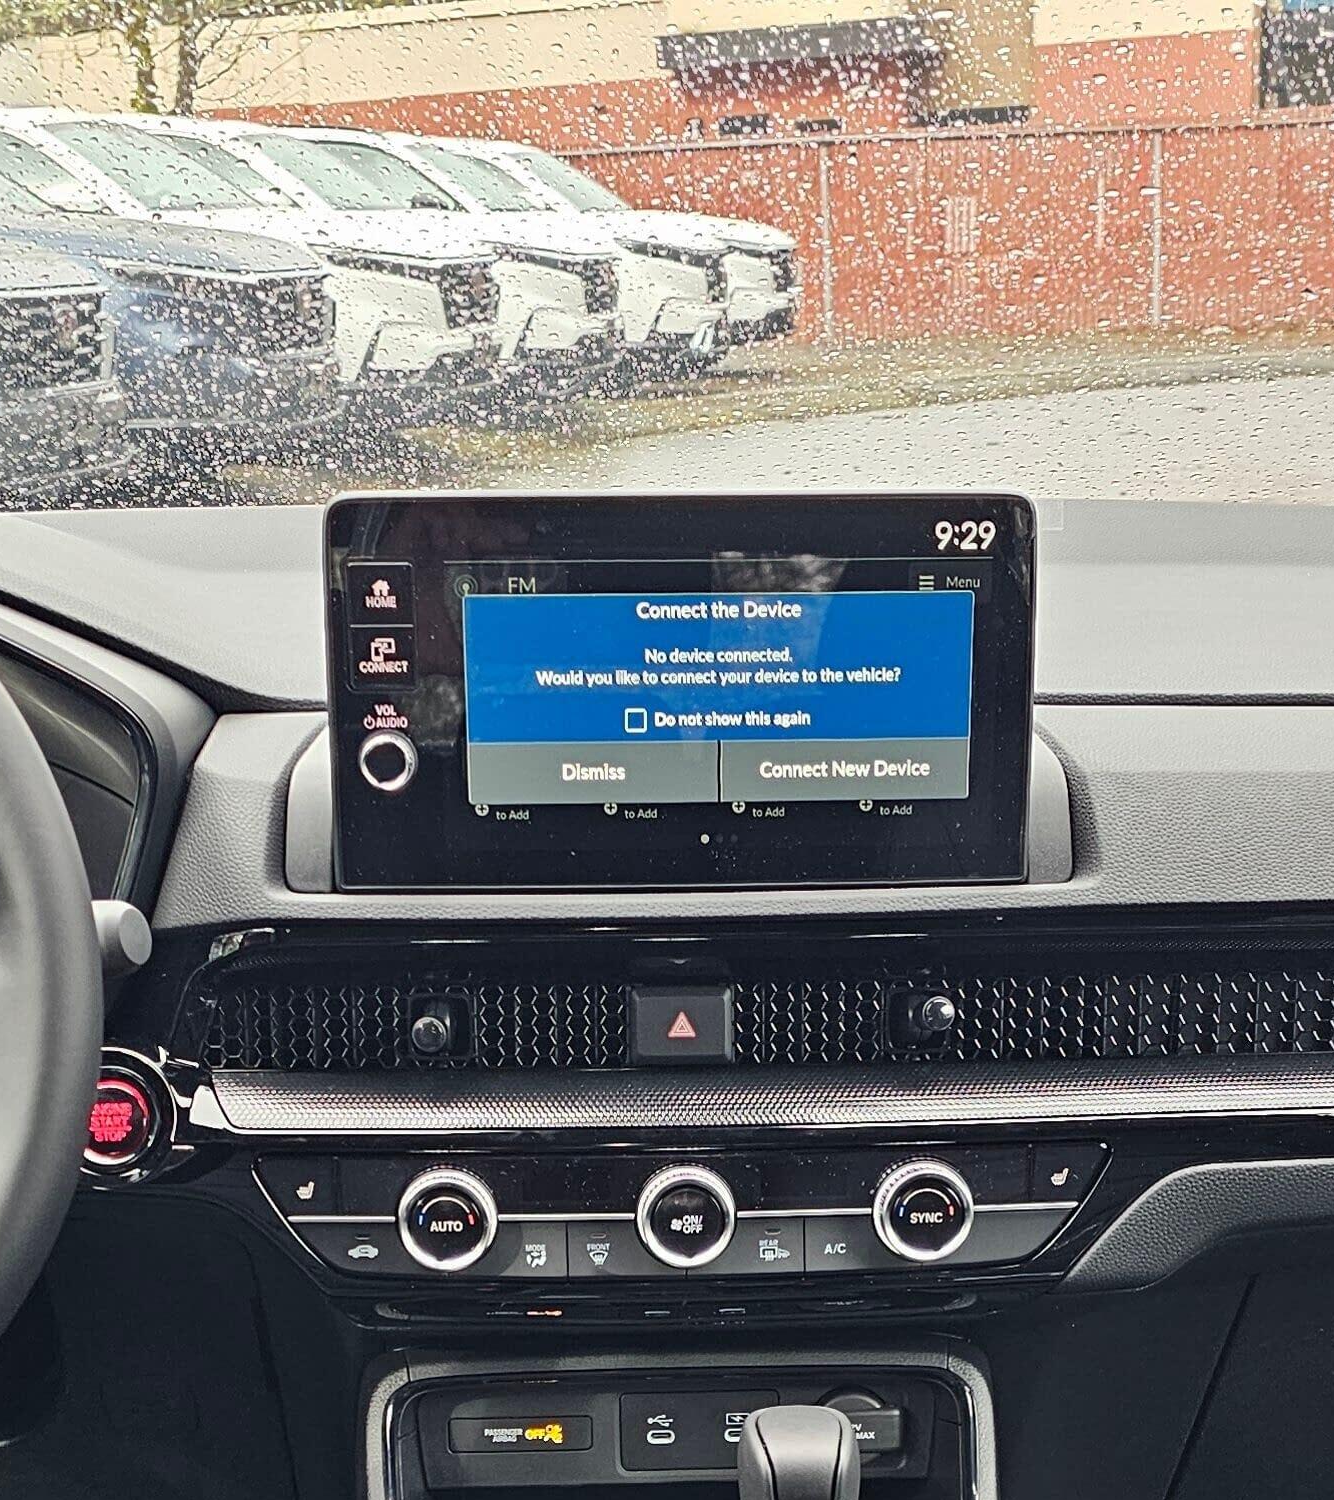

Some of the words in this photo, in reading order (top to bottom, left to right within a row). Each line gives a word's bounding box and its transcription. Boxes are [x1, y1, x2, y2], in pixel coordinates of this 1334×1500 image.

[934, 520, 997, 551] 9:29
[507, 576, 537, 594] FM
[946, 576, 981, 589] Menu
[365, 596, 397, 609] HOME
[636, 601, 708, 619] Connect
[711, 600, 740, 618] the
[743, 600, 803, 618] Device
[644, 649, 668, 664] No
[669, 648, 715, 664] device
[716, 647, 793, 663] connected.
[358, 660, 409, 674] CONNECT
[535, 670, 584, 687] Would
[586, 673, 613, 688] you
[615, 670, 640, 685] like
[643, 671, 659, 685] to
[661, 669, 717, 685] connect
[719, 671, 751, 687] your
[754, 668, 800, 684] device
[802, 668, 818, 683] to
[820, 667, 844, 683] the
[846, 666, 902, 683] vehicle?
[374, 704, 397, 716] VOL
[376, 715, 408, 729] AUDIO
[654, 711, 677, 728] Do
[678, 711, 704, 727] not
[705, 710, 744, 727] show
[745, 710, 771, 726] this
[773, 710, 811, 729] again
[561, 762, 627, 782] Dismiss
[759, 760, 829, 779] Connect
[831, 760, 871, 778] New
[873, 758, 931, 778] Device
[495, 809, 507, 821] to
[509, 809, 530, 821] Add
[624, 808, 636, 819] to
[636, 808, 658, 819] Add
[752, 807, 763, 818] to
[765, 806, 786, 818] Add
[879, 805, 891, 816] to
[892, 804, 913, 816] Add
[90, 1115, 130, 1127] START
[94, 1130, 127, 1142] STOP
[682, 1215, 703, 1226] ON/
[909, 1211, 944, 1224] SYNC
[430, 1220, 464, 1233] AUTO
[682, 1224, 703, 1235] OFF
[525, 1243, 547, 1252] MODE
[587, 1242, 611, 1251] FRONT
[758, 1239, 779, 1247] REAR
[824, 1243, 847, 1256] A/C
[524, 1427, 546, 1440] OFF
